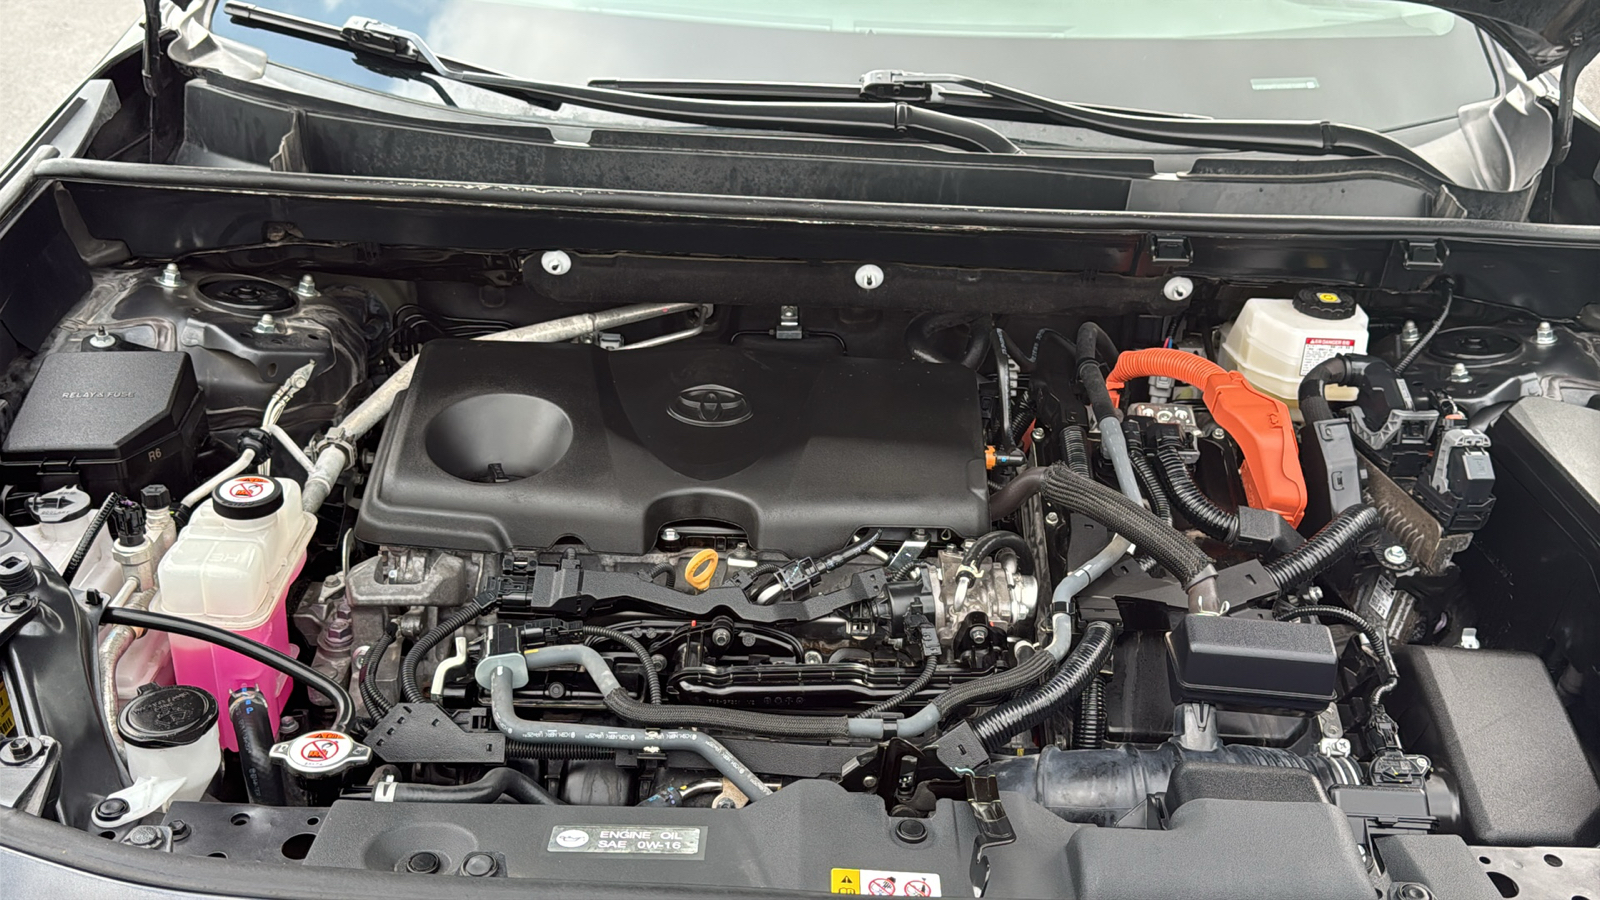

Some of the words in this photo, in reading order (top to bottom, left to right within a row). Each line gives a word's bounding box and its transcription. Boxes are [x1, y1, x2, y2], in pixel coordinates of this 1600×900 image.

[61, 391, 96, 399] RELAY
[107, 391, 137, 399] FUSE
[148, 448, 161, 462] R6
[600, 831, 651, 839] ENGINE
[660, 831, 683, 840] OIL
[597, 840, 627, 848] SAE
[637, 841, 682, 849] 0W-16
